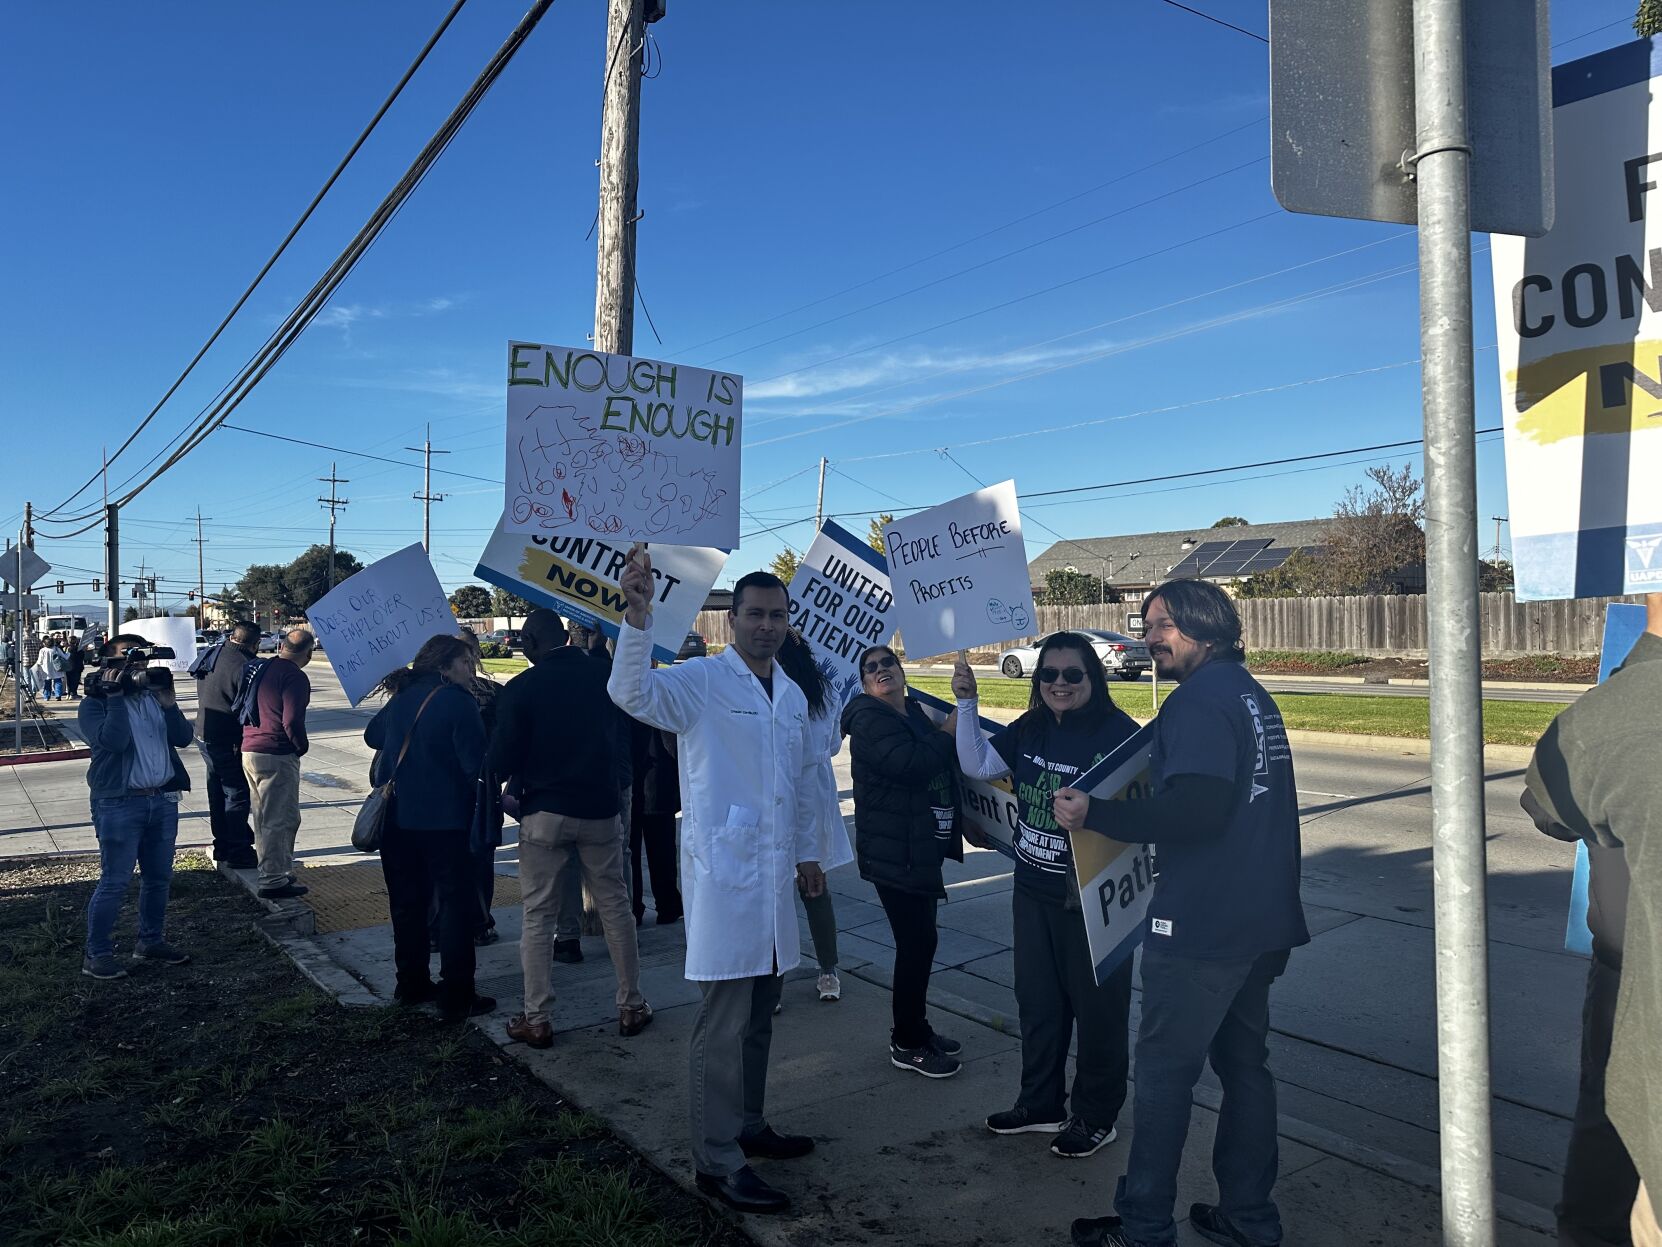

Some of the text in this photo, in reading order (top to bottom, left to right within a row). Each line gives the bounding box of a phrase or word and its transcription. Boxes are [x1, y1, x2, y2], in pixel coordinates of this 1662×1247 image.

[1623, 150, 1662, 223] F
[1511, 247, 1662, 338] CON
[508, 343, 738, 405] ENOUGH IS
[1599, 355, 1662, 409] N
[599, 395, 735, 447] ENOUGH
[887, 519, 1011, 569] PEOPLE BEFORE
[546, 563, 629, 613] NOW
[801, 576, 885, 644] FOR OUR
[821, 554, 893, 614] UNITED
[910, 575, 973, 604] PROFITS
[314, 587, 381, 636] DOES OUR
[338, 597, 443, 678] CARE ABOUT US?
[340, 593, 412, 644] EMPLOYER
[787, 599, 868, 664] PATIENT
[1054, 762, 1079, 775] COUNTY
[966, 788, 1002, 824] ent
[1098, 843, 1152, 927] Pati
